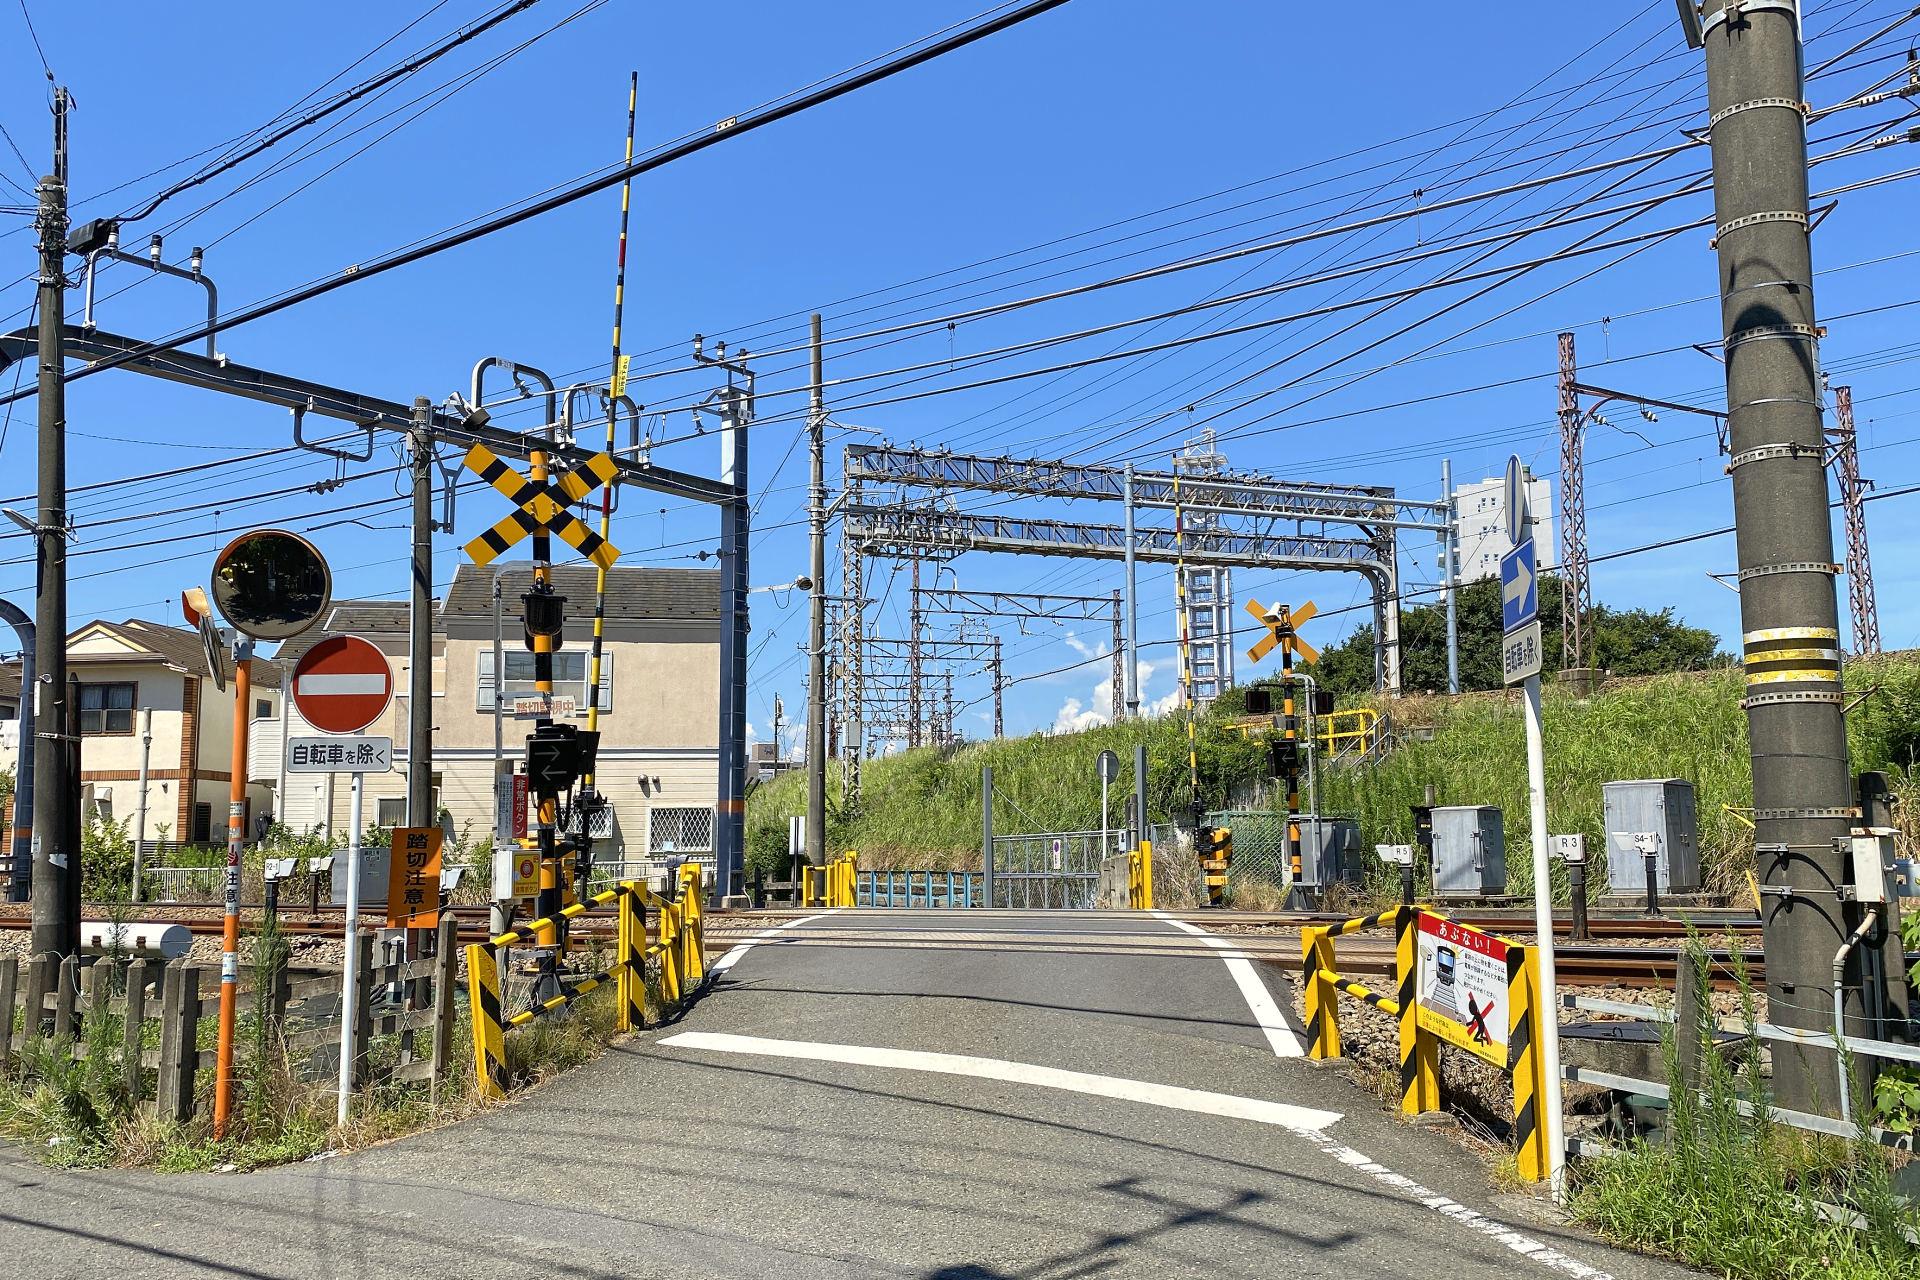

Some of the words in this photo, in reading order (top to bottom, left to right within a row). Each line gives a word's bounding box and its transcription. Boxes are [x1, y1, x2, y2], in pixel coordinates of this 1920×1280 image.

[1506, 635, 1539, 674] 自転車を除く
[293, 744, 385, 765] 自転車を除く
[516, 779, 526, 835] 非常ボタン
[1634, 835, 1653, 843] S4-1
[266, 862, 278, 870] R2-1
[403, 833, 429, 922] 踏切注意!
[226, 871, 239, 903] 注意
[1439, 922, 1491, 954] あぶない!
